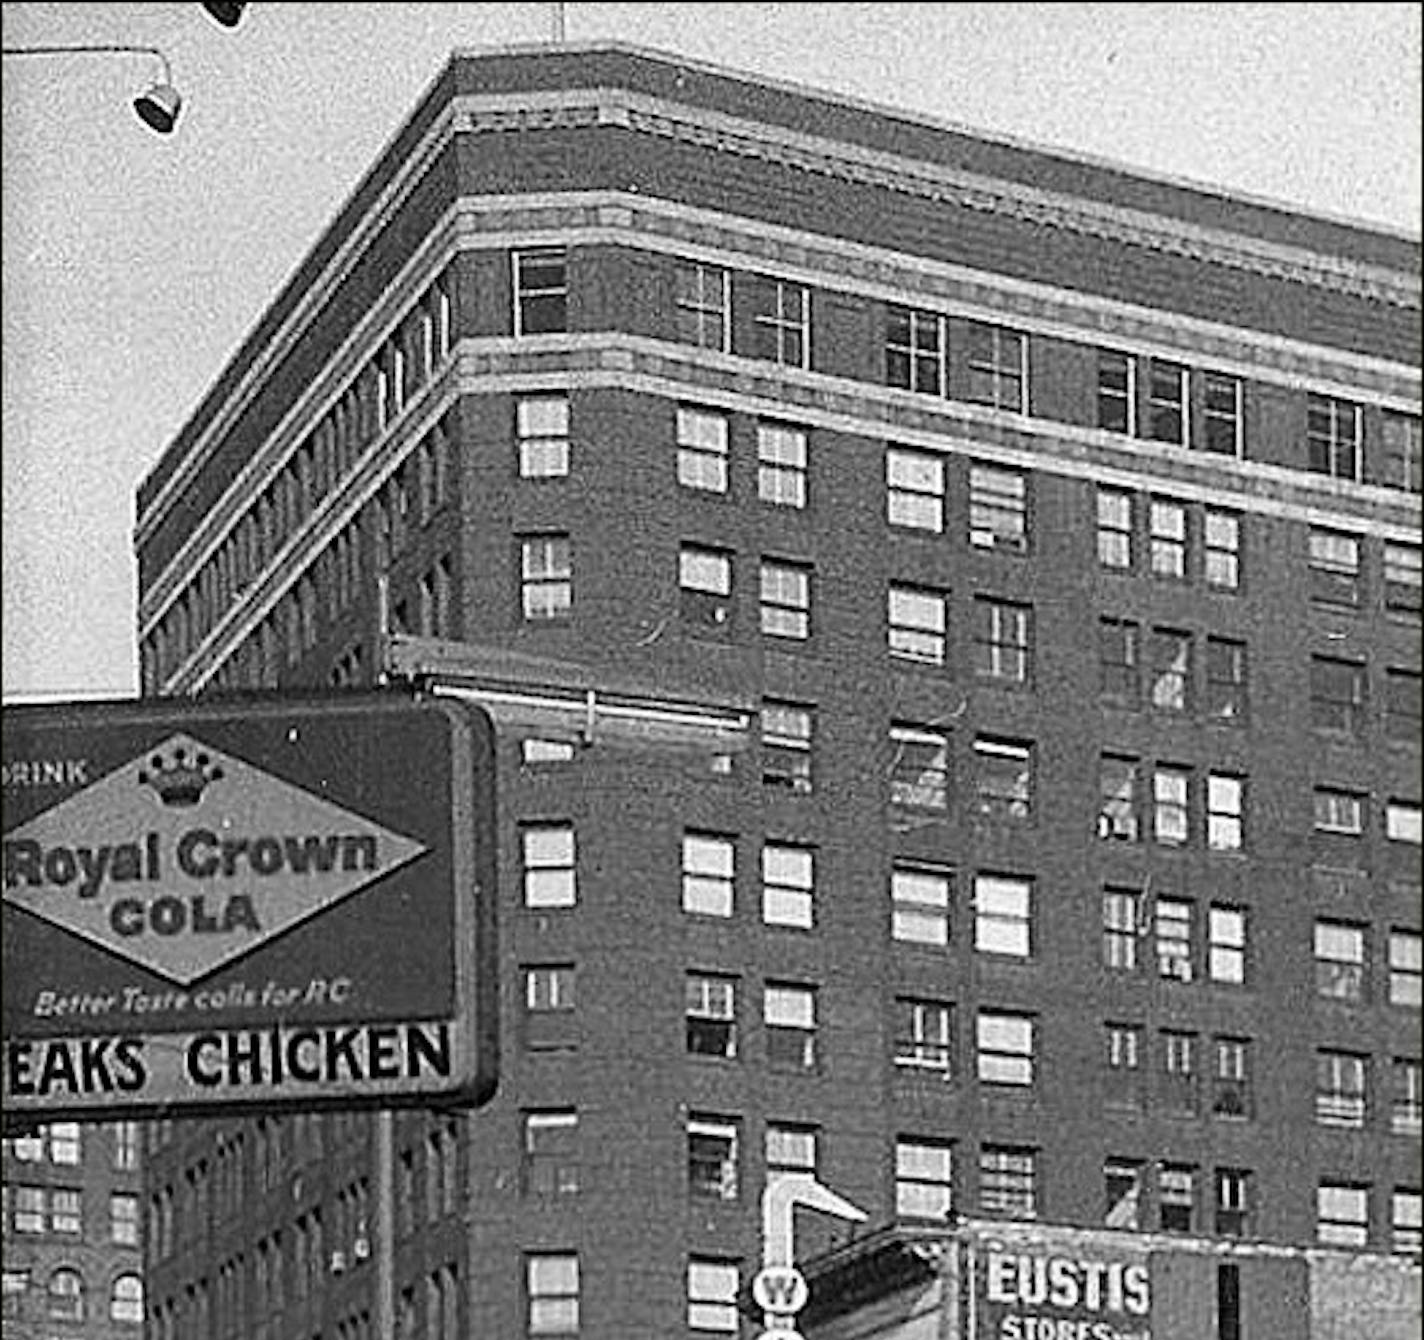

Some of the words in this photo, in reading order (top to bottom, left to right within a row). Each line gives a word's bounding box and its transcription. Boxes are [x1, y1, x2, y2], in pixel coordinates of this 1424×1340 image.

[4, 831, 160, 898] Royal
[177, 829, 379, 878] Crown
[110, 895, 260, 936] COLA
[34, 991, 115, 1016] Better
[123, 986, 189, 1013] Taste
[261, 981, 300, 1007] for
[301, 977, 351, 1004] RC
[9, 1040, 146, 1096] EAKS
[186, 1024, 451, 1087] CHICKEN
[986, 1252, 1150, 1315] EUSTIS
